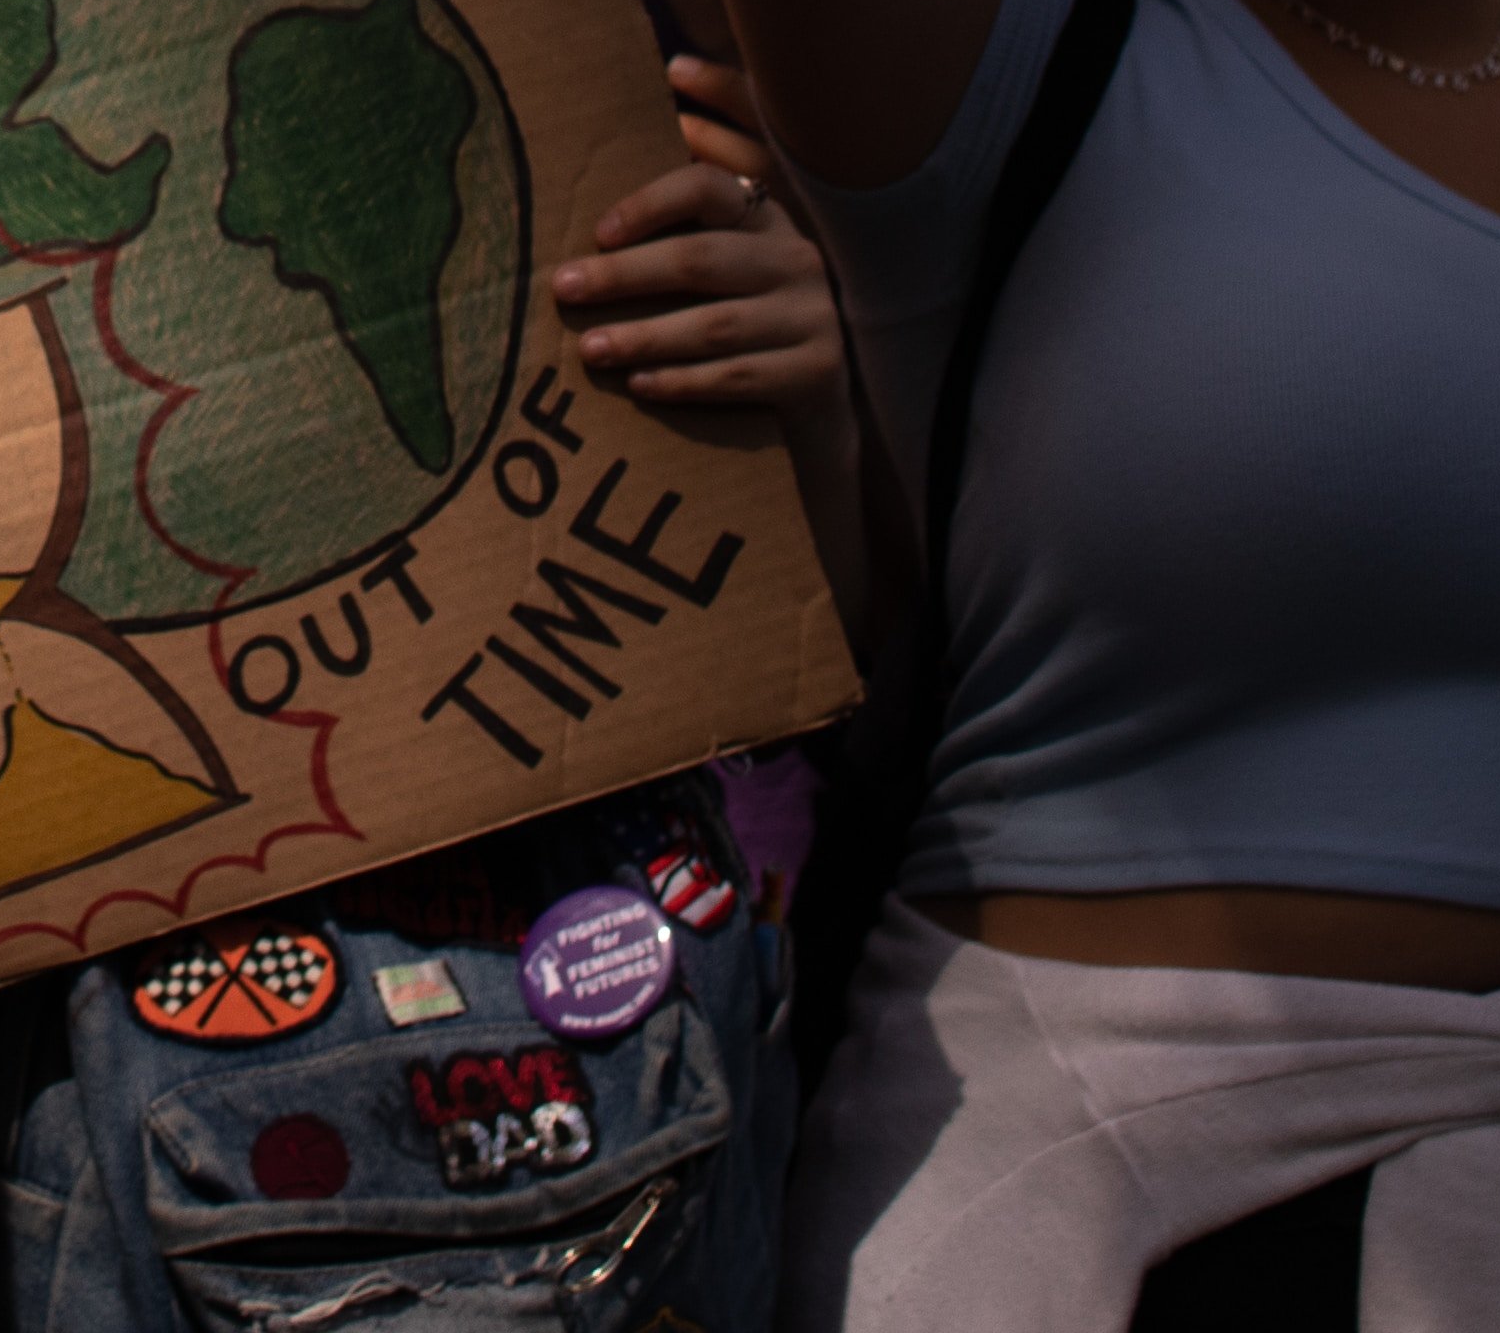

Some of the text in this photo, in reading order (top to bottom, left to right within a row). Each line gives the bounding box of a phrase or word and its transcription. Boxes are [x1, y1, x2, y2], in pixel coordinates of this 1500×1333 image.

[226, 365, 585, 717] OUT OF
[419, 456, 746, 771] TIME
[410, 1045, 591, 1126] LOVE
[438, 1101, 596, 1187] DAD
